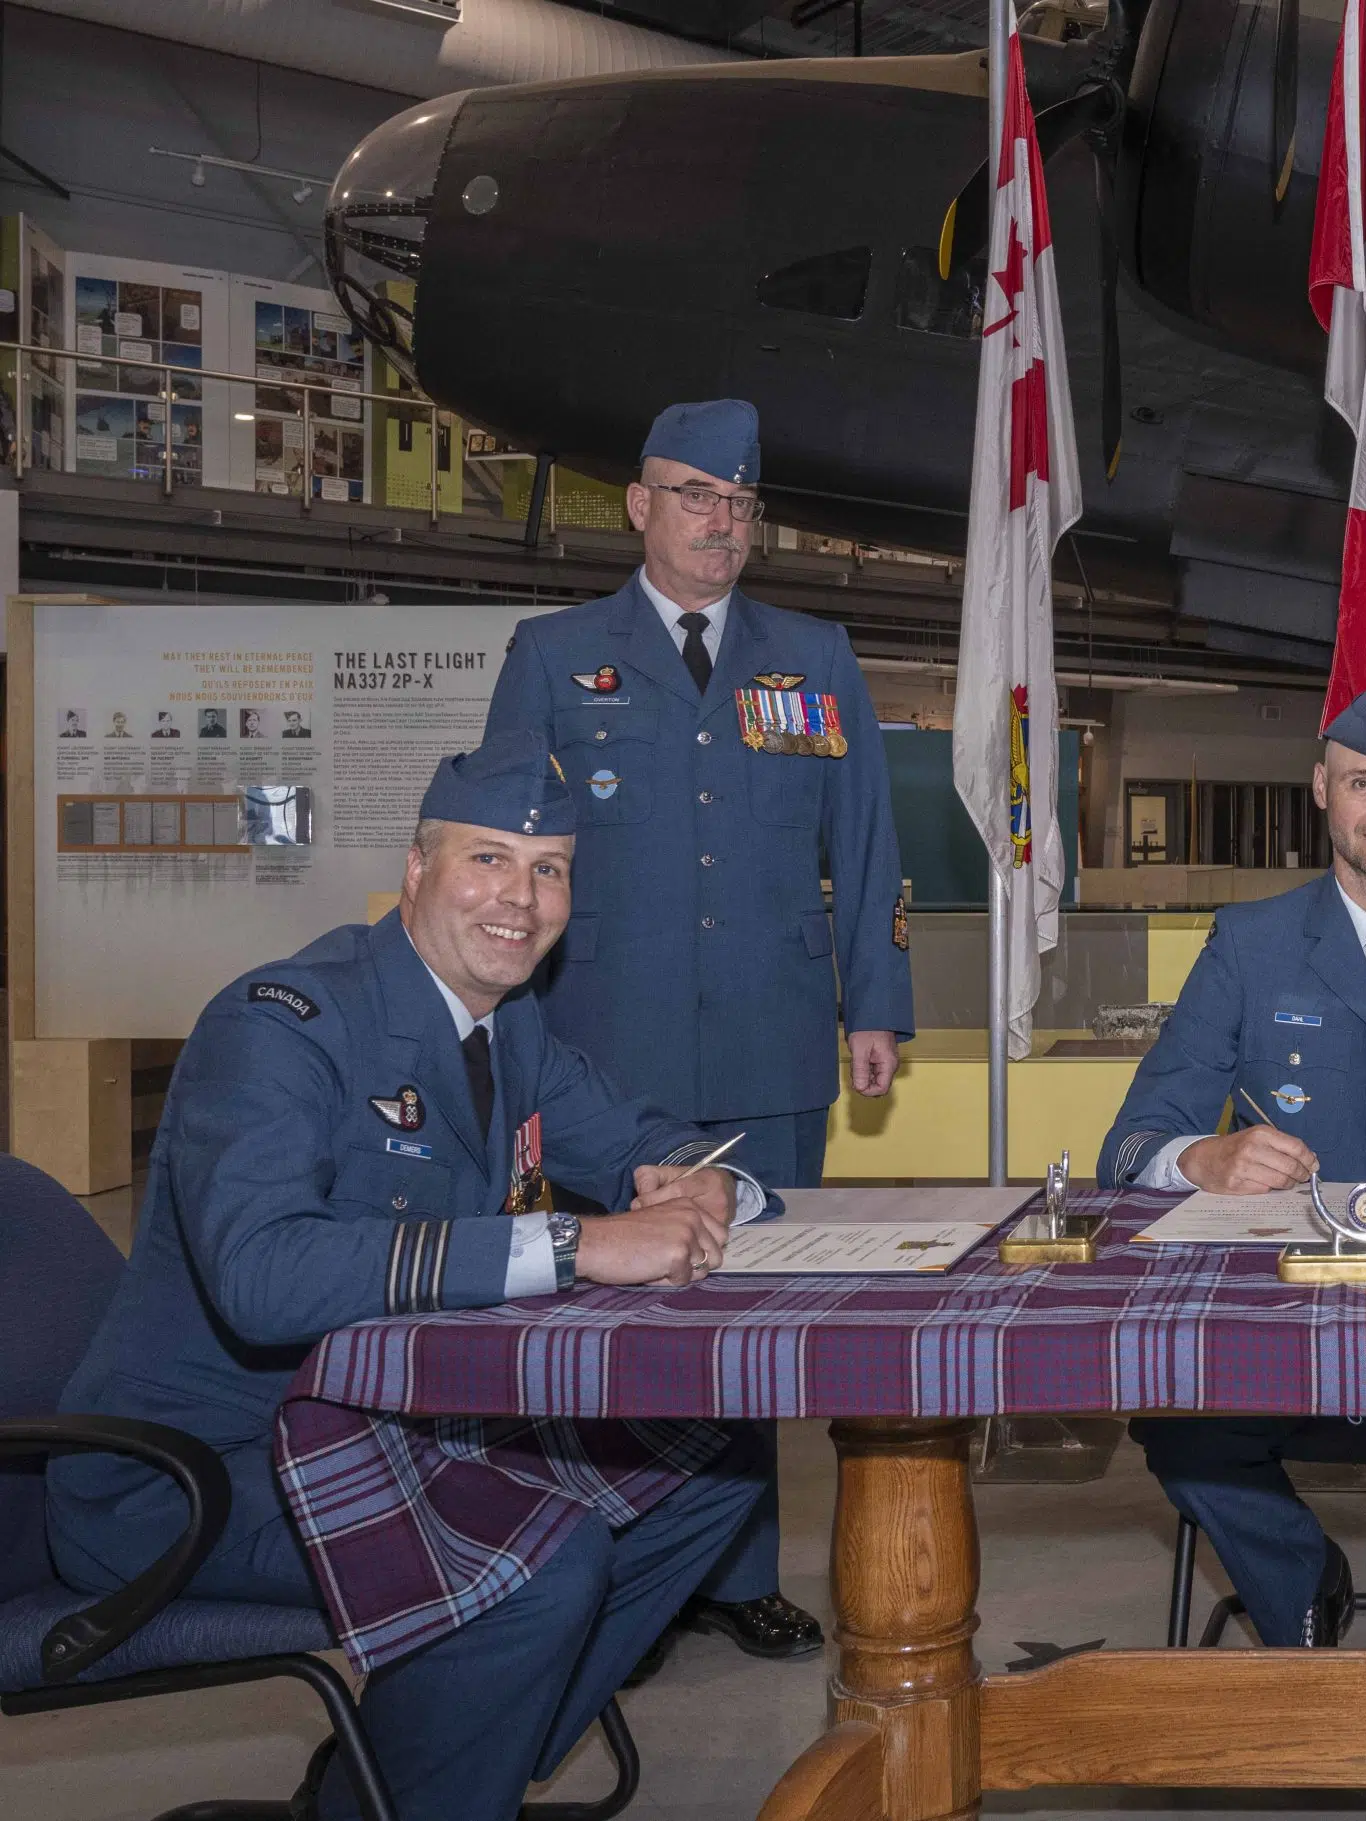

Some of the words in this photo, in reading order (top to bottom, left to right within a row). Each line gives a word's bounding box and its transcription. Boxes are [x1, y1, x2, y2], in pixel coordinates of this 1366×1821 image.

[163, 652, 181, 661] MAY
[184, 652, 206, 661] THEY
[209, 652, 230, 661] REST
[233, 652, 242, 661] IN
[245, 652, 283, 661] ETERNAL
[286, 652, 313, 661] PEACE
[334, 652, 366, 669] THE
[373, 652, 417, 669] LAST
[424, 652, 486, 669] FLIGHT
[194, 664, 216, 673] THEY
[219, 664, 239, 673] WILL
[242, 664, 252, 673] BE
[232, 680, 276, 689] REPOSENT
[280, 680, 290, 689] EN
[293, 680, 314, 689] PAIX
[334, 672, 386, 689] NA337
[392, 673, 433, 689] 2P-X
[168, 692, 192, 701] NOUS
[195, 692, 218, 701] NOUS
[257, 986, 310, 1016] CANADA
